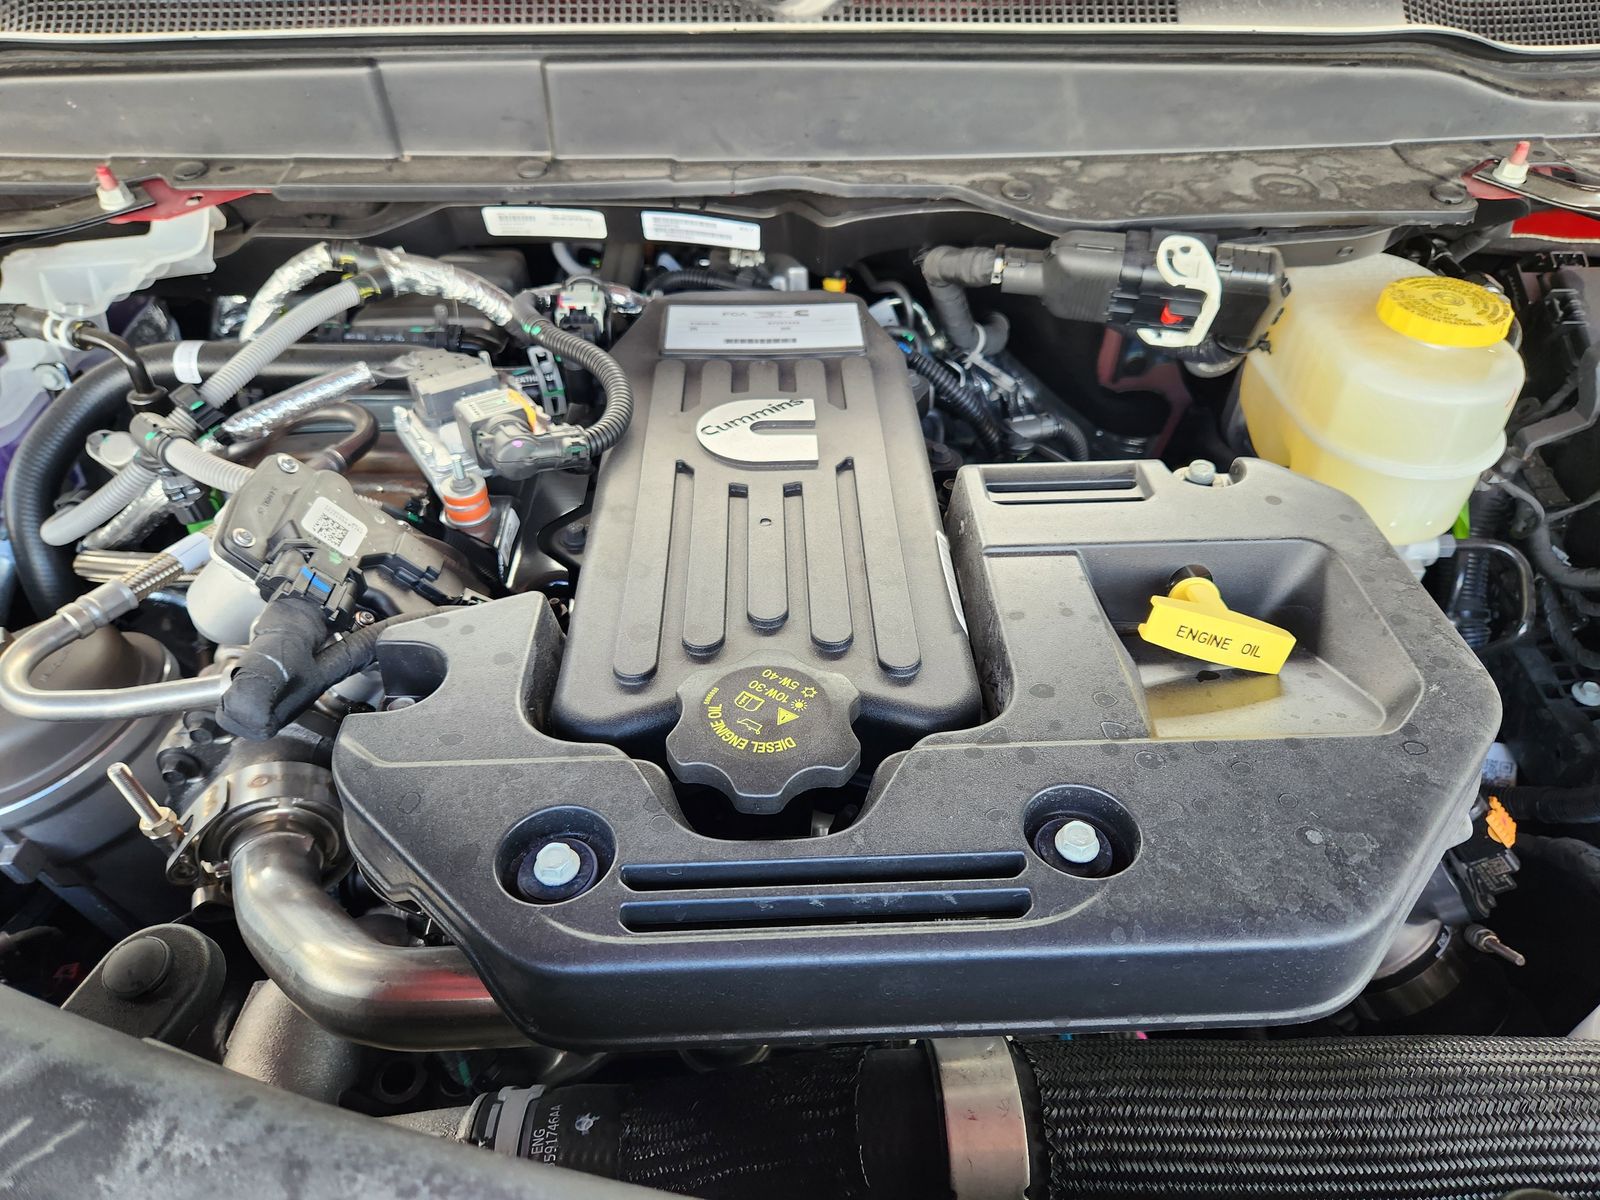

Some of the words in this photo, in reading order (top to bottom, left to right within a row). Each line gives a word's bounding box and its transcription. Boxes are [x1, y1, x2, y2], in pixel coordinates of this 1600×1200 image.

[701, 399, 805, 435] Cummins
[1176, 625, 1233, 651] ENGINE
[1240, 643, 1262, 658] OIL
[748, 679, 790, 704] 10W-30
[761, 668, 800, 691] 5W-40
[707, 703, 723, 719] OIL
[710, 719, 749, 750] ENGINE
[751, 736, 797, 753] DIESEL
[531, 1128, 545, 1155] ENG
